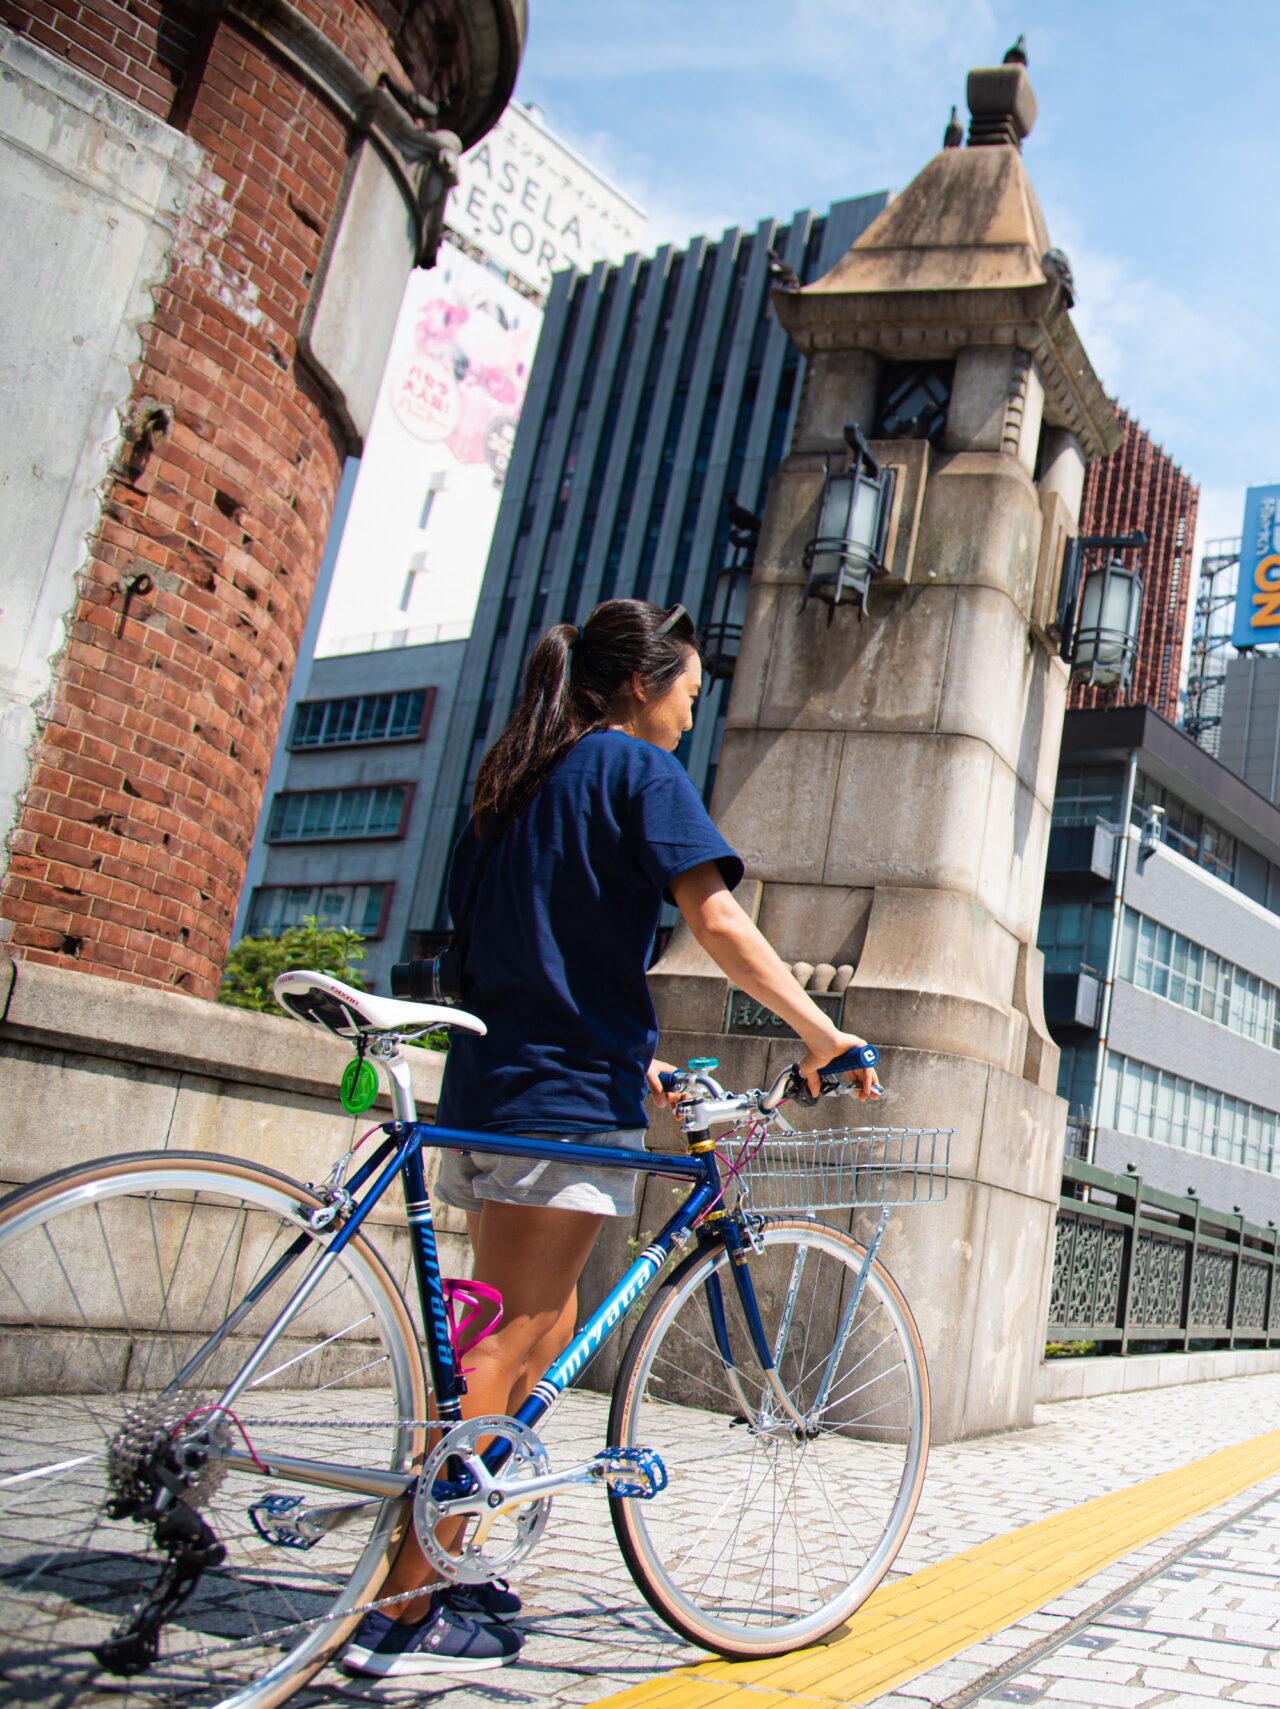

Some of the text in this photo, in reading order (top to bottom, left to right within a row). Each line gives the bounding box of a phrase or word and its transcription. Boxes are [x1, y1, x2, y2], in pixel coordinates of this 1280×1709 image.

[452, 183, 576, 271] ESOR
[468, 143, 582, 249] ASELA
[420, 1227, 453, 1366] miyata
[557, 1266, 651, 1385] miyata
